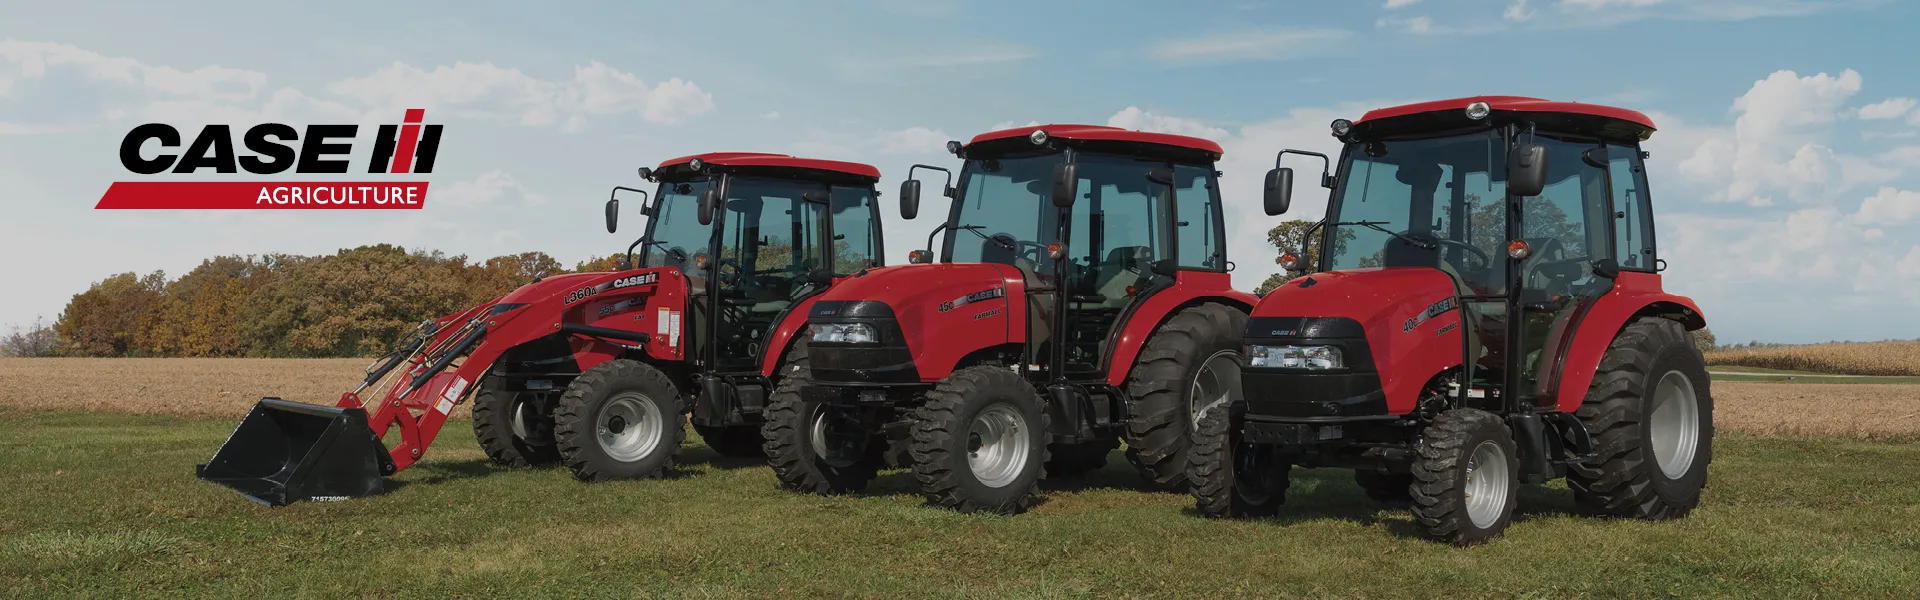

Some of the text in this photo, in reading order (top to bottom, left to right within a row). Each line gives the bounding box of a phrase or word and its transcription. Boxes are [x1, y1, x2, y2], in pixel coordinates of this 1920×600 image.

[564, 271, 656, 305] L360A CASE IH
[967, 290, 993, 303] CASE
[974, 309, 1002, 321] FARMALL
[1428, 299, 1449, 317] CASE
[1435, 321, 1458, 337] FARMALL
